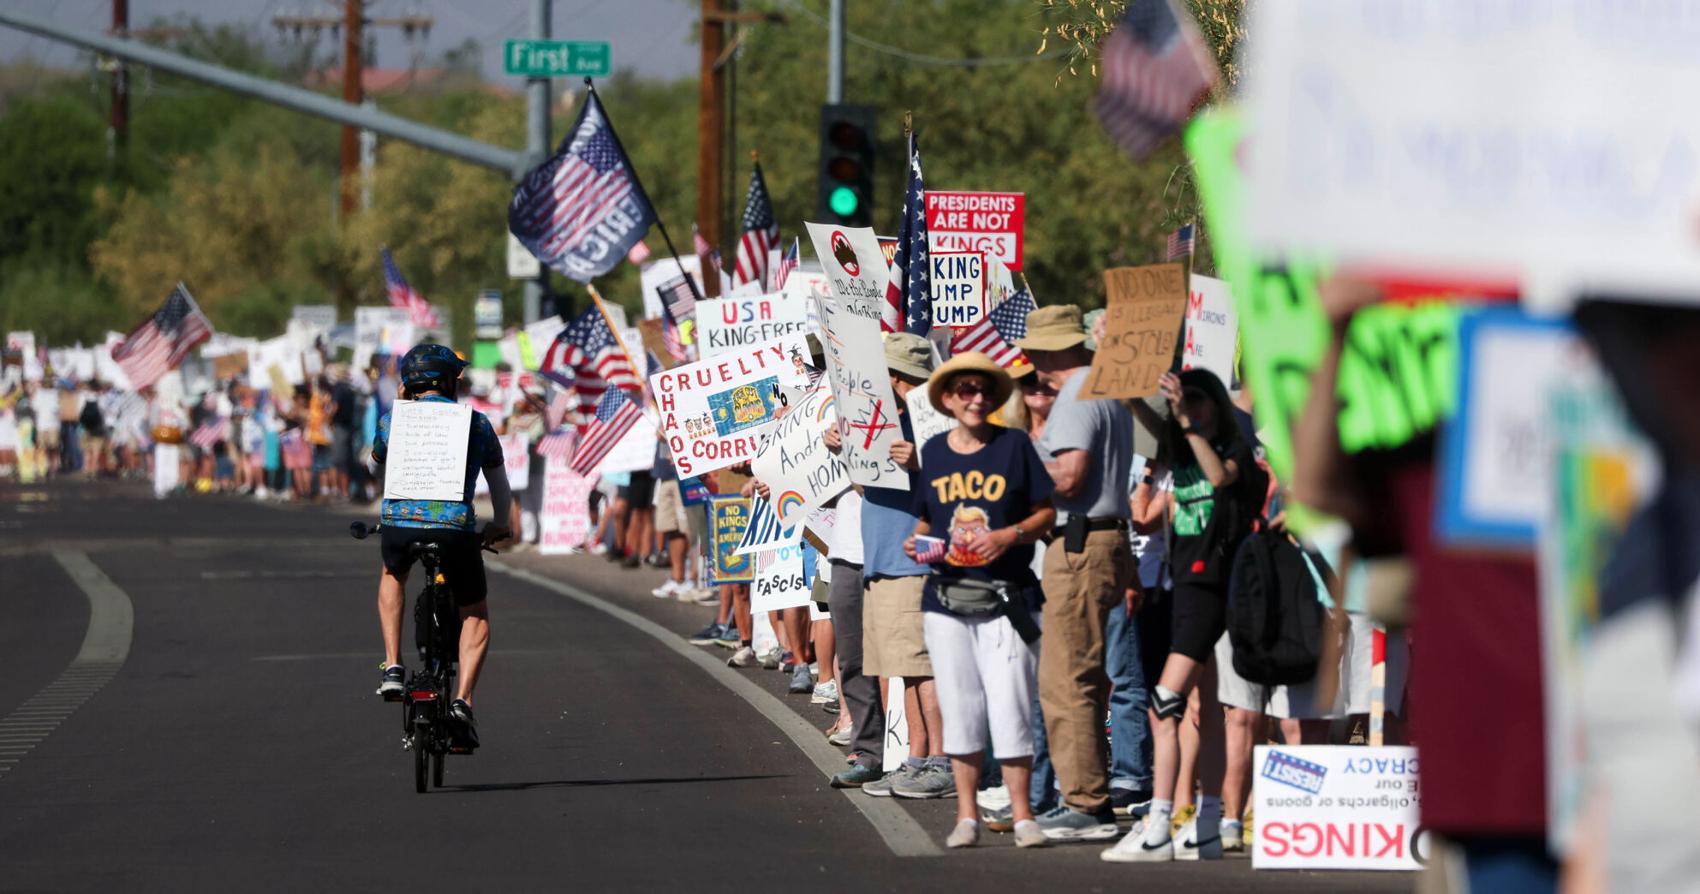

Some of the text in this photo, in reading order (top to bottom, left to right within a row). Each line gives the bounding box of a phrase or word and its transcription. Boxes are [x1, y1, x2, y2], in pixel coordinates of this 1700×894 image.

[511, 44, 568, 71] First
[929, 195, 1015, 212] PRESIDENTS
[933, 212, 1011, 230] ARE NOT
[881, 244, 895, 261] NO
[934, 256, 980, 280] KING
[1112, 269, 1181, 299] NO ONE
[721, 300, 773, 325] USA
[659, 342, 785, 393] CRUELTY
[1090, 363, 1163, 396] LAND
[930, 469, 1007, 504] TACO
[725, 505, 740, 516] NO
[719, 516, 748, 528] KINGS
[1375, 779, 1403, 790] our
[1266, 795, 1313, 808] goons
[1318, 798, 1333, 808] or
[1337, 794, 1410, 810] oligarchs
[1262, 821, 1405, 859] KINGS
